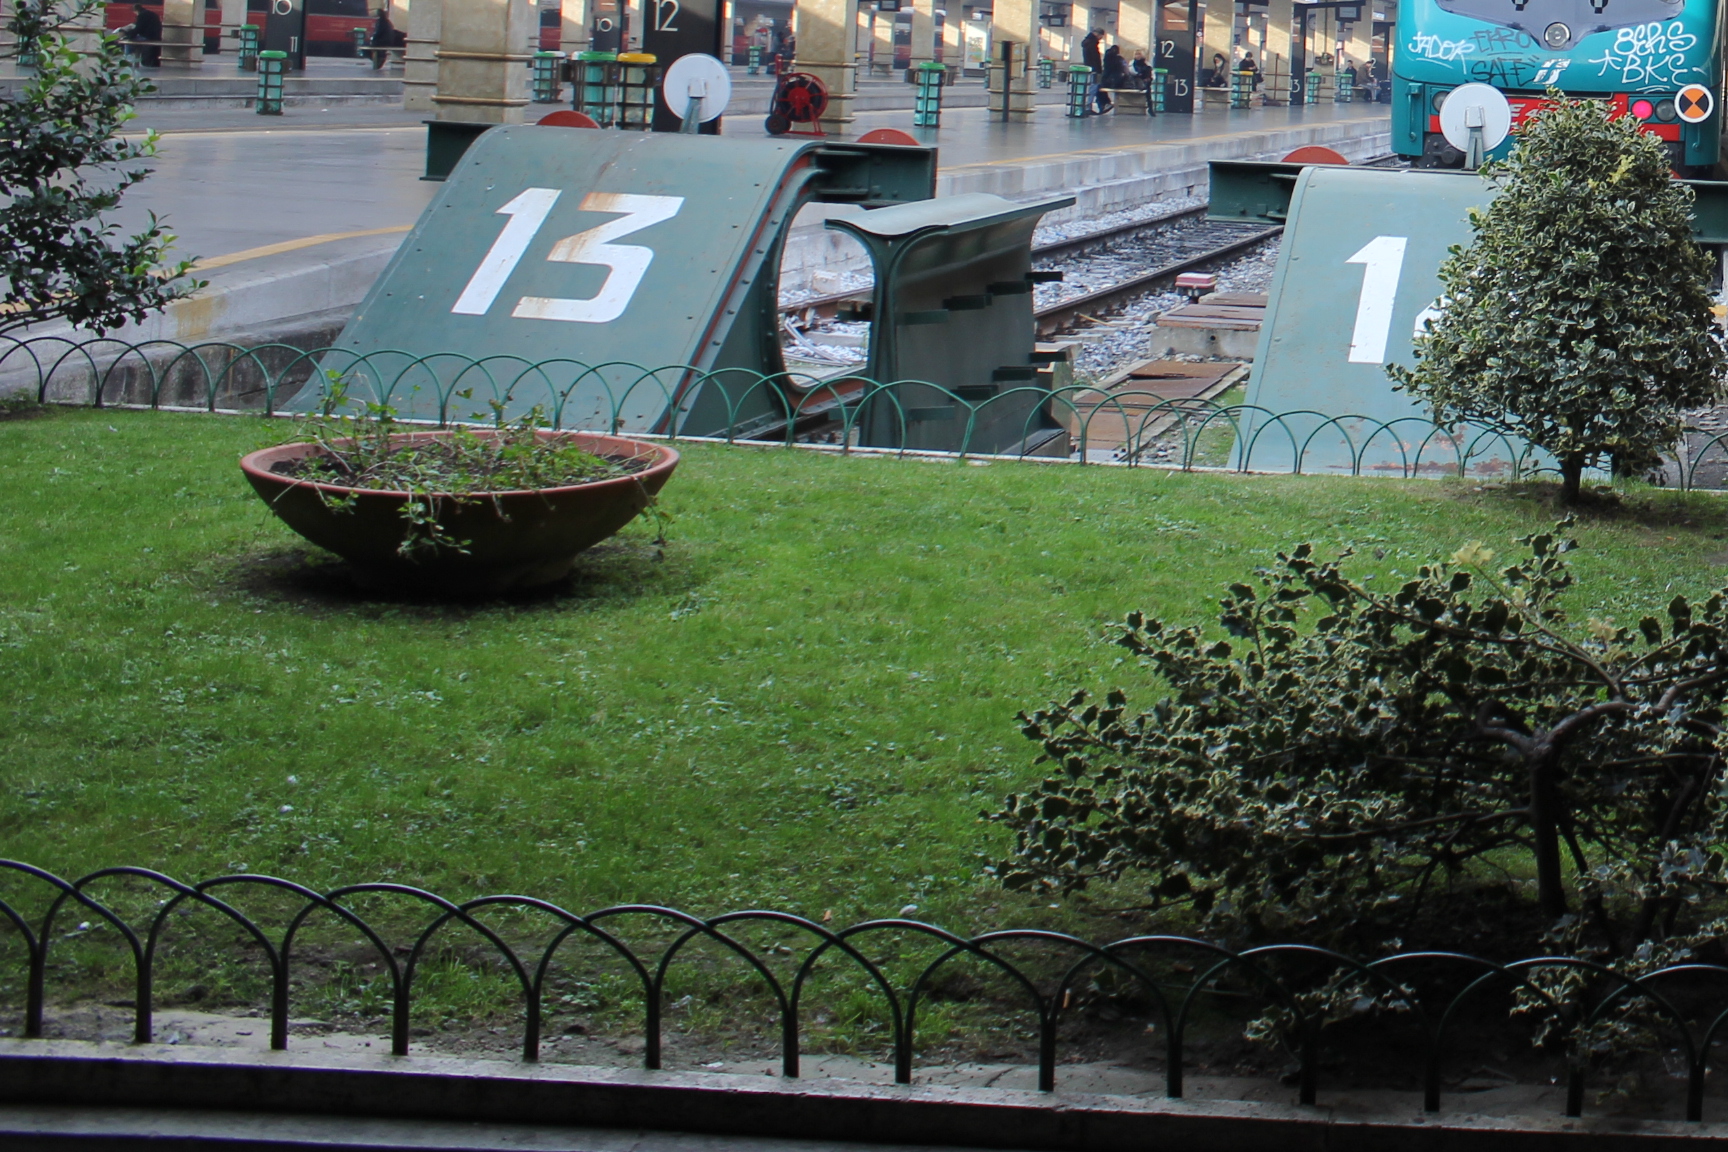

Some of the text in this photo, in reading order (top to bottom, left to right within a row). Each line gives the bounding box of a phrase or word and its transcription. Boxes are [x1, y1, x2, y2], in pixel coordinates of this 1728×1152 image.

[596, 17, 613, 32] 10
[290, 36, 298, 52] 11
[1160, 40, 1175, 58] 12
[1174, 79, 1189, 96] 13
[451, 187, 685, 324] 13
